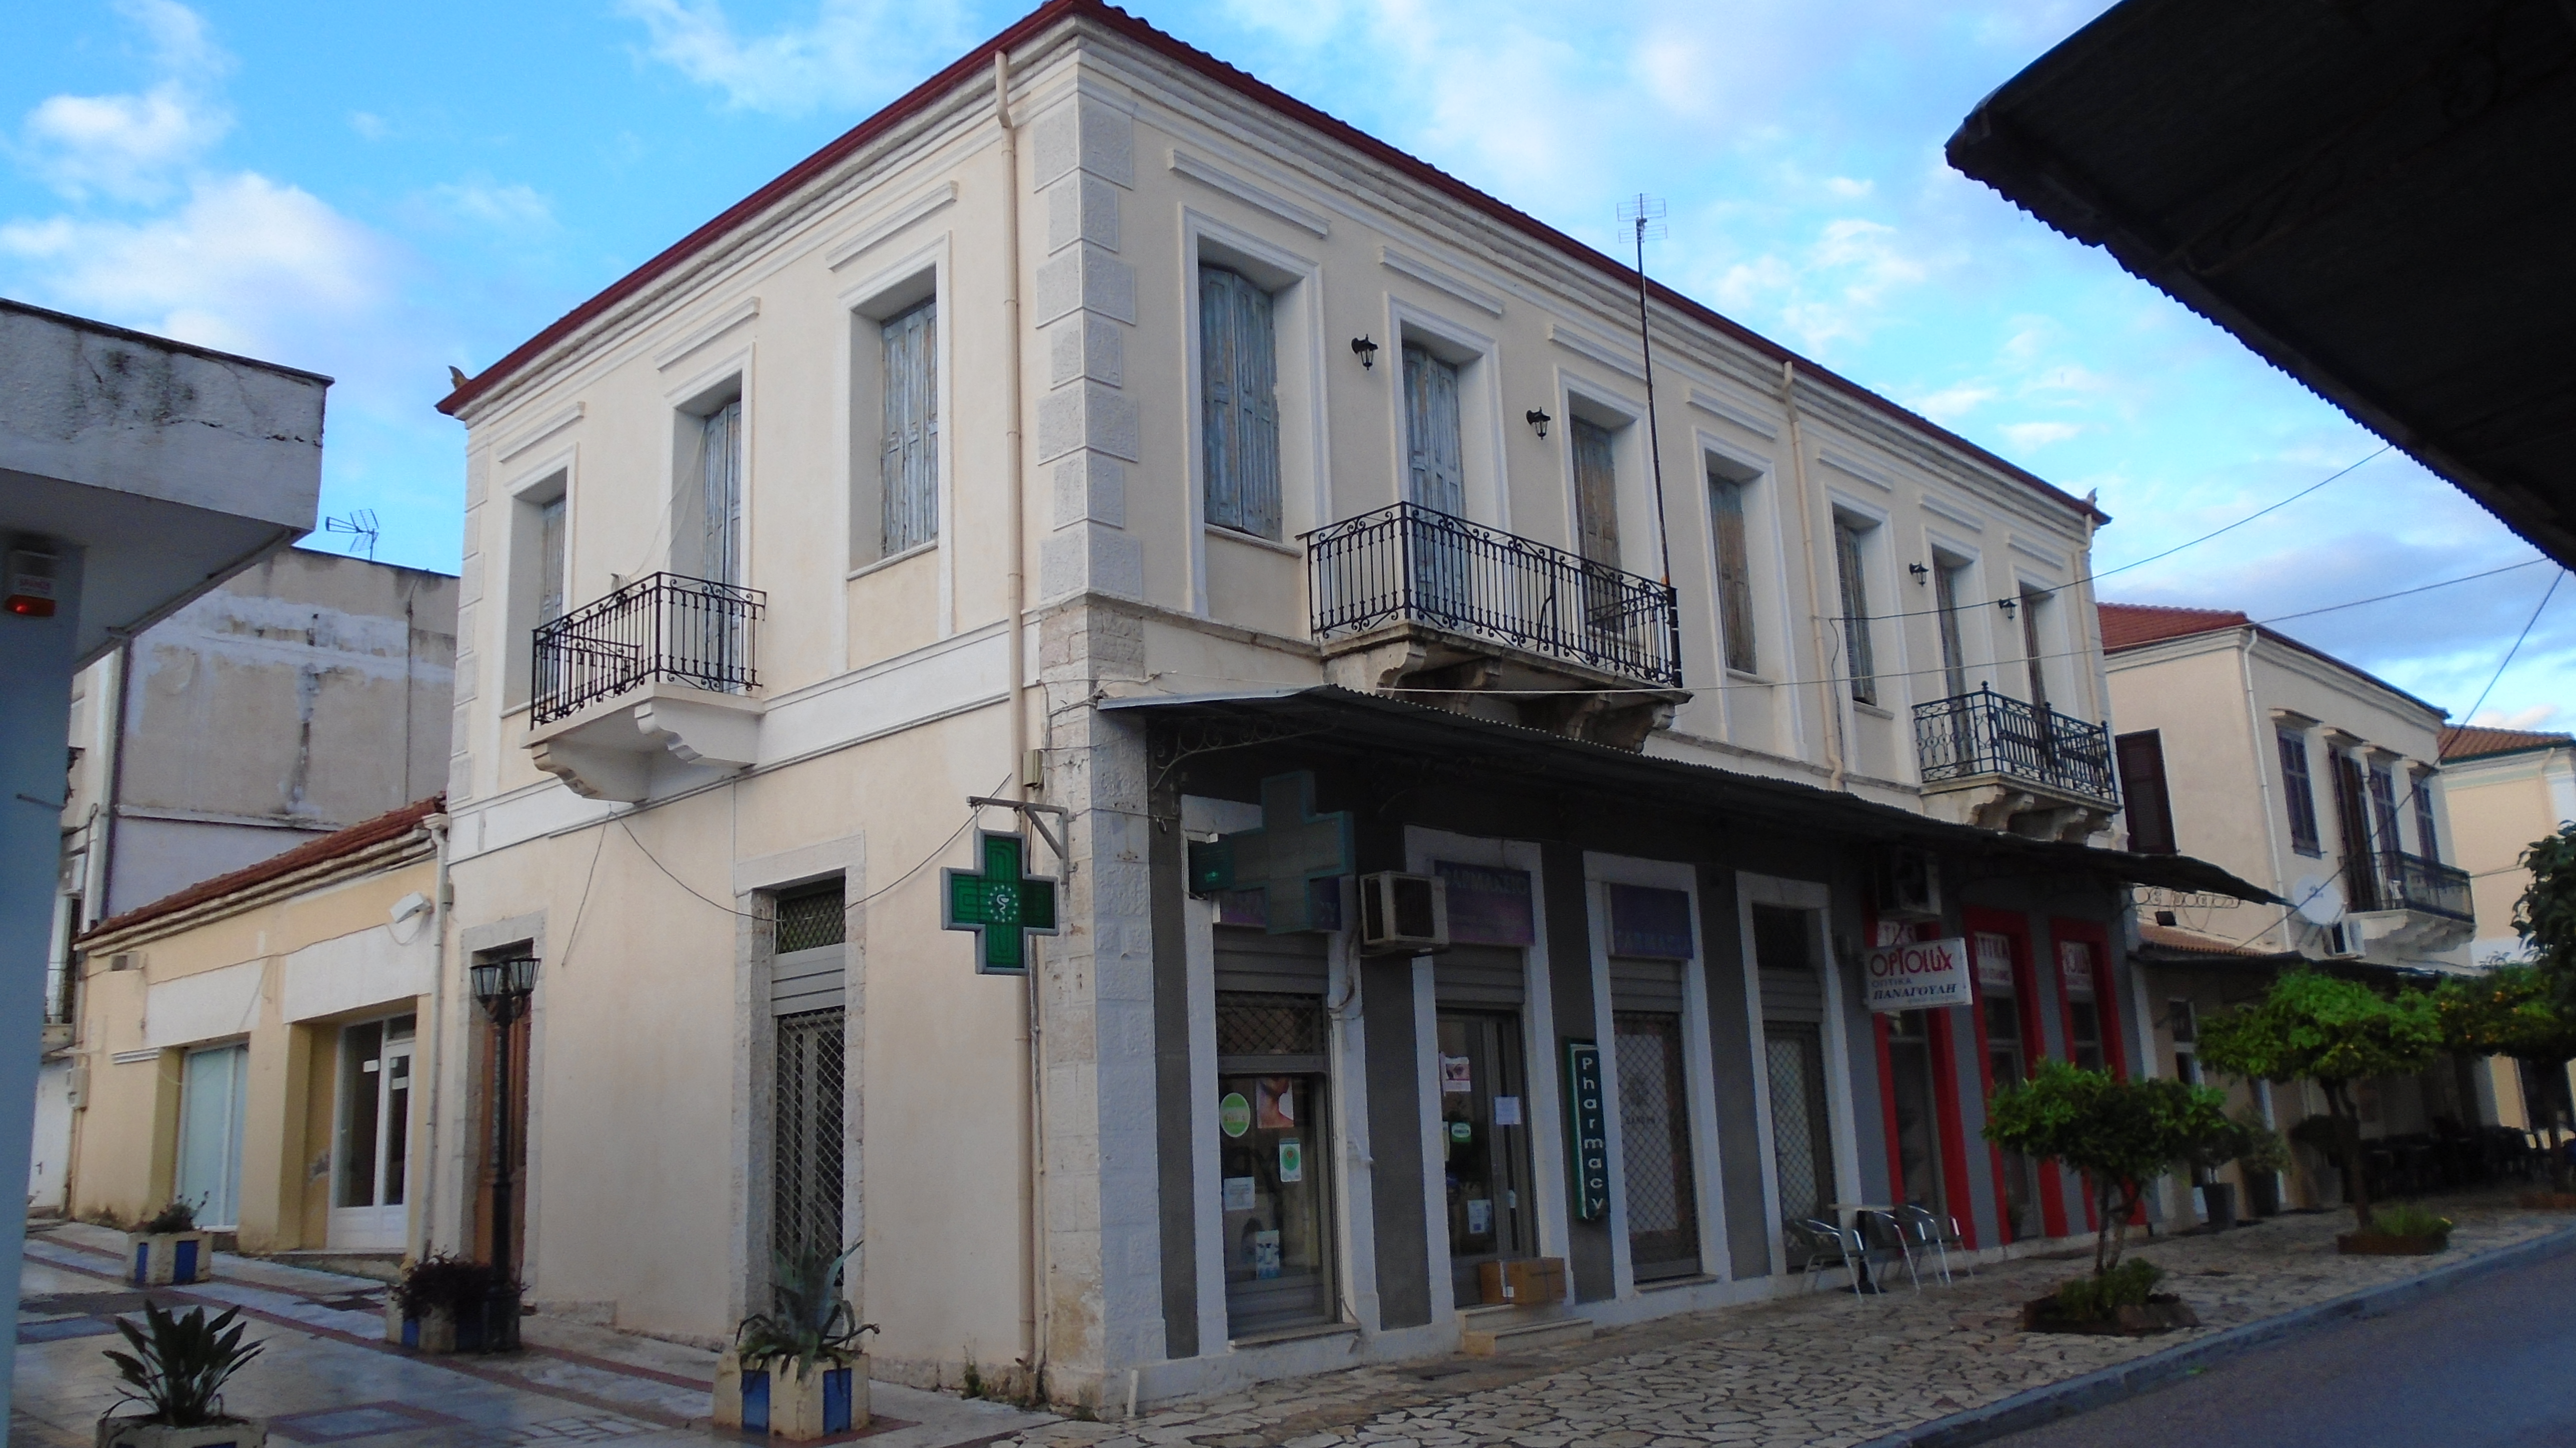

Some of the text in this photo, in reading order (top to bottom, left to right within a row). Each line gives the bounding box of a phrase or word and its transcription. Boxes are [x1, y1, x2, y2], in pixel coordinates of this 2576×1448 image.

[1872, 978, 1912, 988] ΟΠΤΙΚΑ
[1874, 984, 1956, 1000] ΠΑΝΑΓΟΥΛΗ
[1582, 1057, 1604, 1214] Pharmacy
